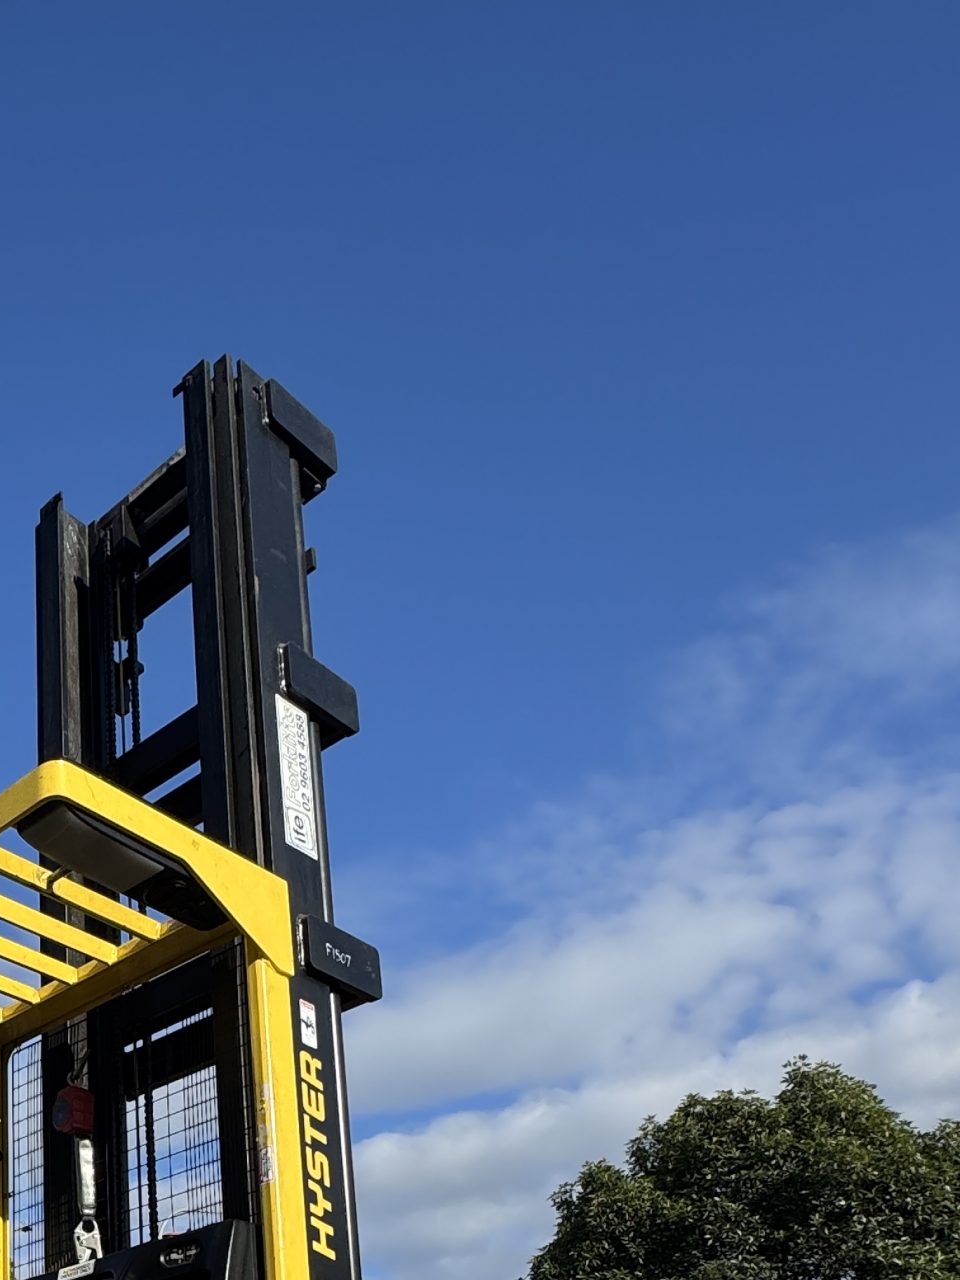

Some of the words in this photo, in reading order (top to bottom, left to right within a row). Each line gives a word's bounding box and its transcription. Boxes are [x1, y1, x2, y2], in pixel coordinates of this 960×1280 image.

[298, 752, 309, 790] 9603
[301, 792, 311, 812] 02
[299, 1050, 336, 1261] HYSTER
